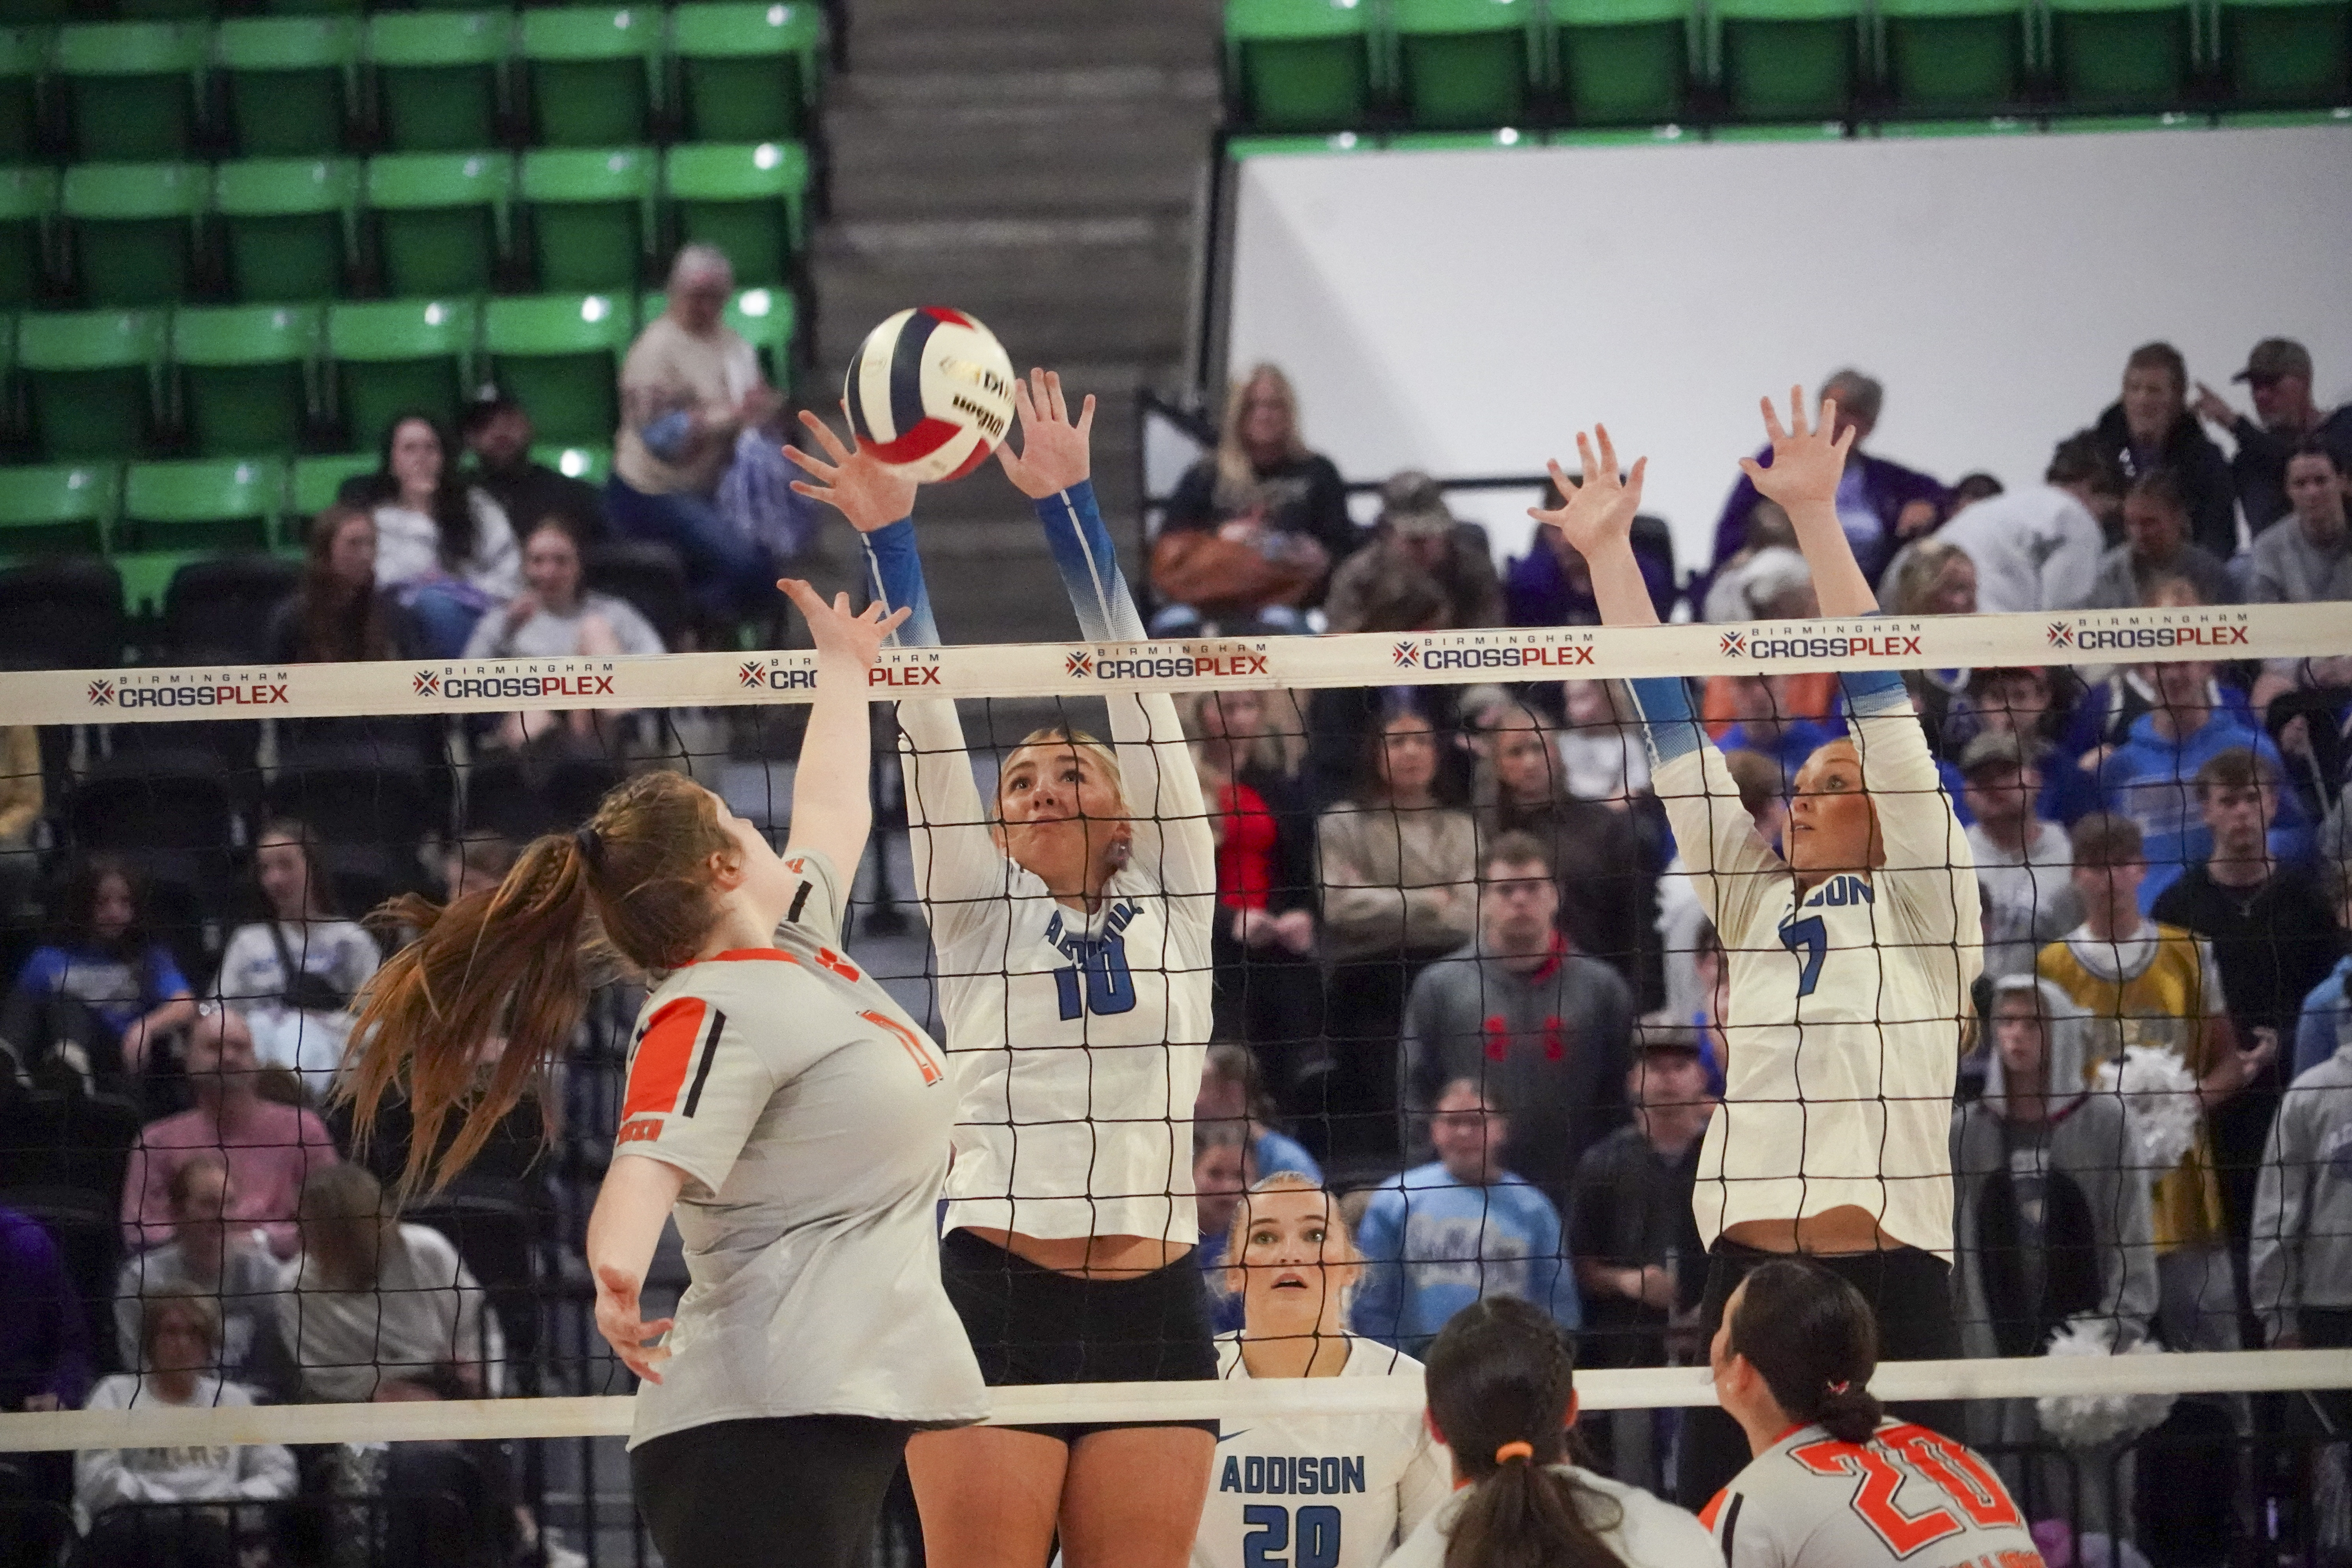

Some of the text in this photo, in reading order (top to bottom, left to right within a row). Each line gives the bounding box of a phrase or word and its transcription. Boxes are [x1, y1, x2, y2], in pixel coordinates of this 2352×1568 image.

[1752, 624, 1920, 636] BIRMINGHAM
[2079, 613, 2248, 626] BIRMINGHAM
[1098, 643, 1266, 656] BIRMINGHAM
[1425, 633, 1593, 646] BIRMINGHAM
[1751, 636, 1922, 659] CROSSPLEX
[2078, 626, 2249, 650] CROSSPLEX
[445, 663, 613, 675] BIRMINGHAM
[771, 653, 939, 666] BIRGHAM
[1097, 655, 1268, 679] CROSSPLEX
[1423, 646, 1595, 670] CROSSPLEX
[120, 672, 288, 684] BIRMINGHAM
[444, 676, 615, 698] CROSSPLEX
[770, 666, 941, 689] CRPLEX
[119, 684, 289, 708] CROSSPLEX
[1779, 915, 1827, 998] 7
[1053, 936, 1137, 1021] 10
[1220, 1455, 1366, 1494] ADDISON
[1786, 1422, 2023, 1561] 20
[1243, 1504, 1341, 1568] 20
